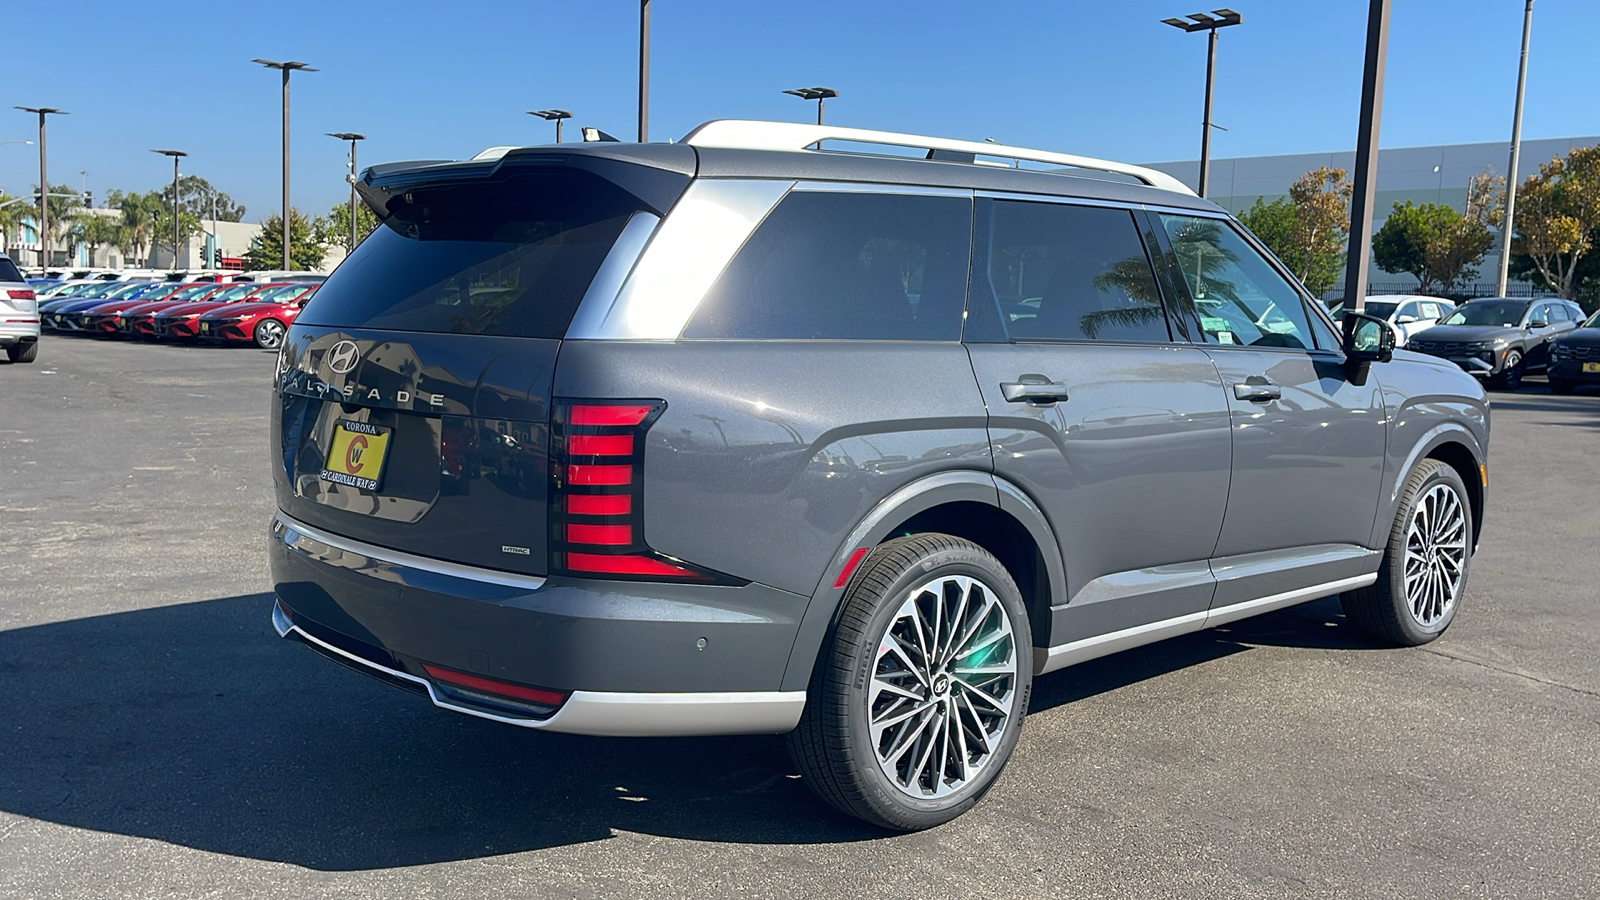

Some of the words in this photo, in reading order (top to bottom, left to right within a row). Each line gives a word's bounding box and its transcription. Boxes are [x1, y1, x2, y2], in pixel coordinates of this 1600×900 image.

[281, 376, 445, 406] PALISADE
[346, 421, 376, 434] CORONA
[327, 471, 356, 486] CARDINALE
[356, 477, 369, 489] WAY
[502, 546, 529, 554] HTRAC
